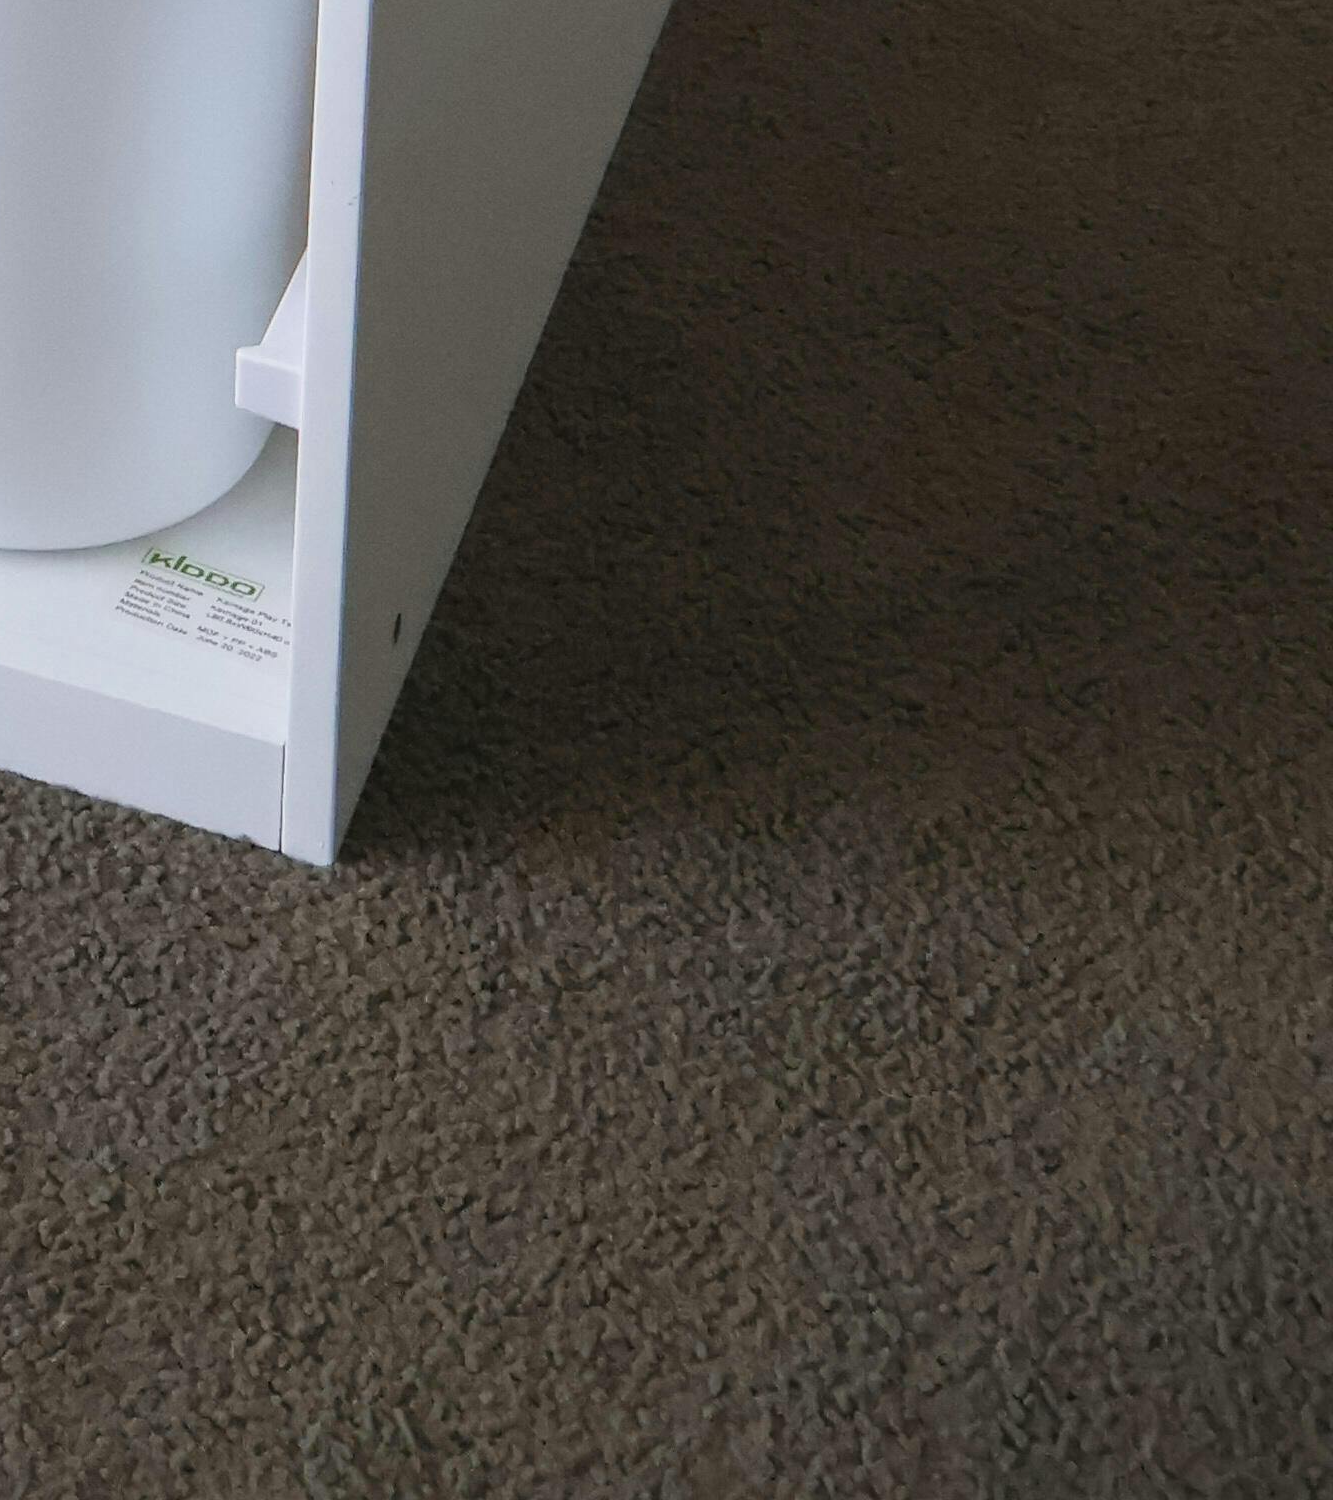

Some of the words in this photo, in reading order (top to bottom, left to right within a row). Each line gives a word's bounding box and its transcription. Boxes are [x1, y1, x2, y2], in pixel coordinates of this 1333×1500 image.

[140, 569, 175, 587] Product
[177, 582, 203, 596] Name
[130, 585, 165, 603] Product
[163, 605, 190, 619] China
